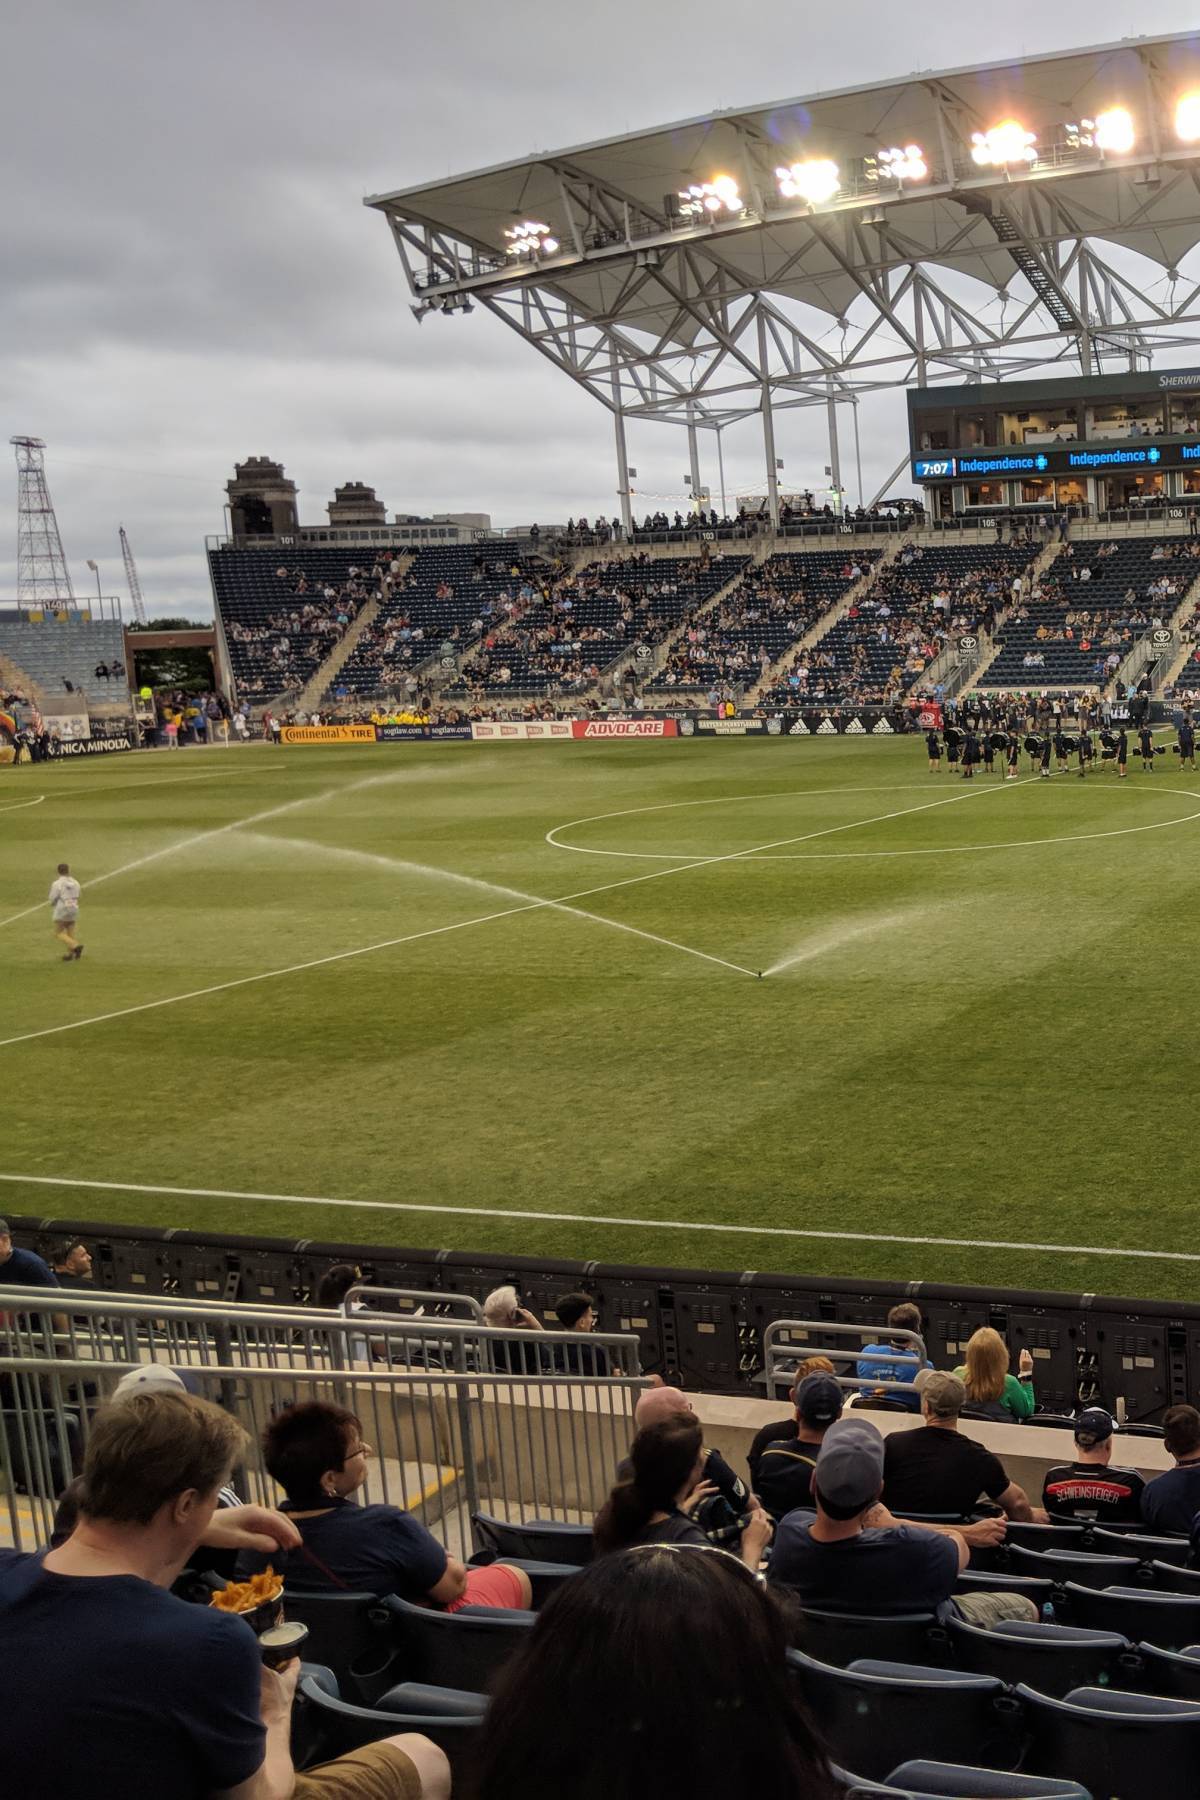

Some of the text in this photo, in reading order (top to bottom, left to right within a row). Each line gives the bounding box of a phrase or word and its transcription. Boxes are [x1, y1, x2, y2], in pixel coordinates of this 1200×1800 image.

[960, 456, 1034, 473] Independence
[1069, 449, 1146, 467] Independence
[922, 463, 948, 475] 7:07
[1169, 508, 1183, 518] 106
[982, 518, 995, 527] 105
[281, 536, 294, 545] 101
[702, 532, 714, 540] 103
[285, 728, 373, 742] Continental TIRE
[586, 722, 663, 737] ADVOCARE
[87, 738, 131, 751] MINOLTA
[1056, 1486, 1120, 1504] SCHWEINSTEIGER
